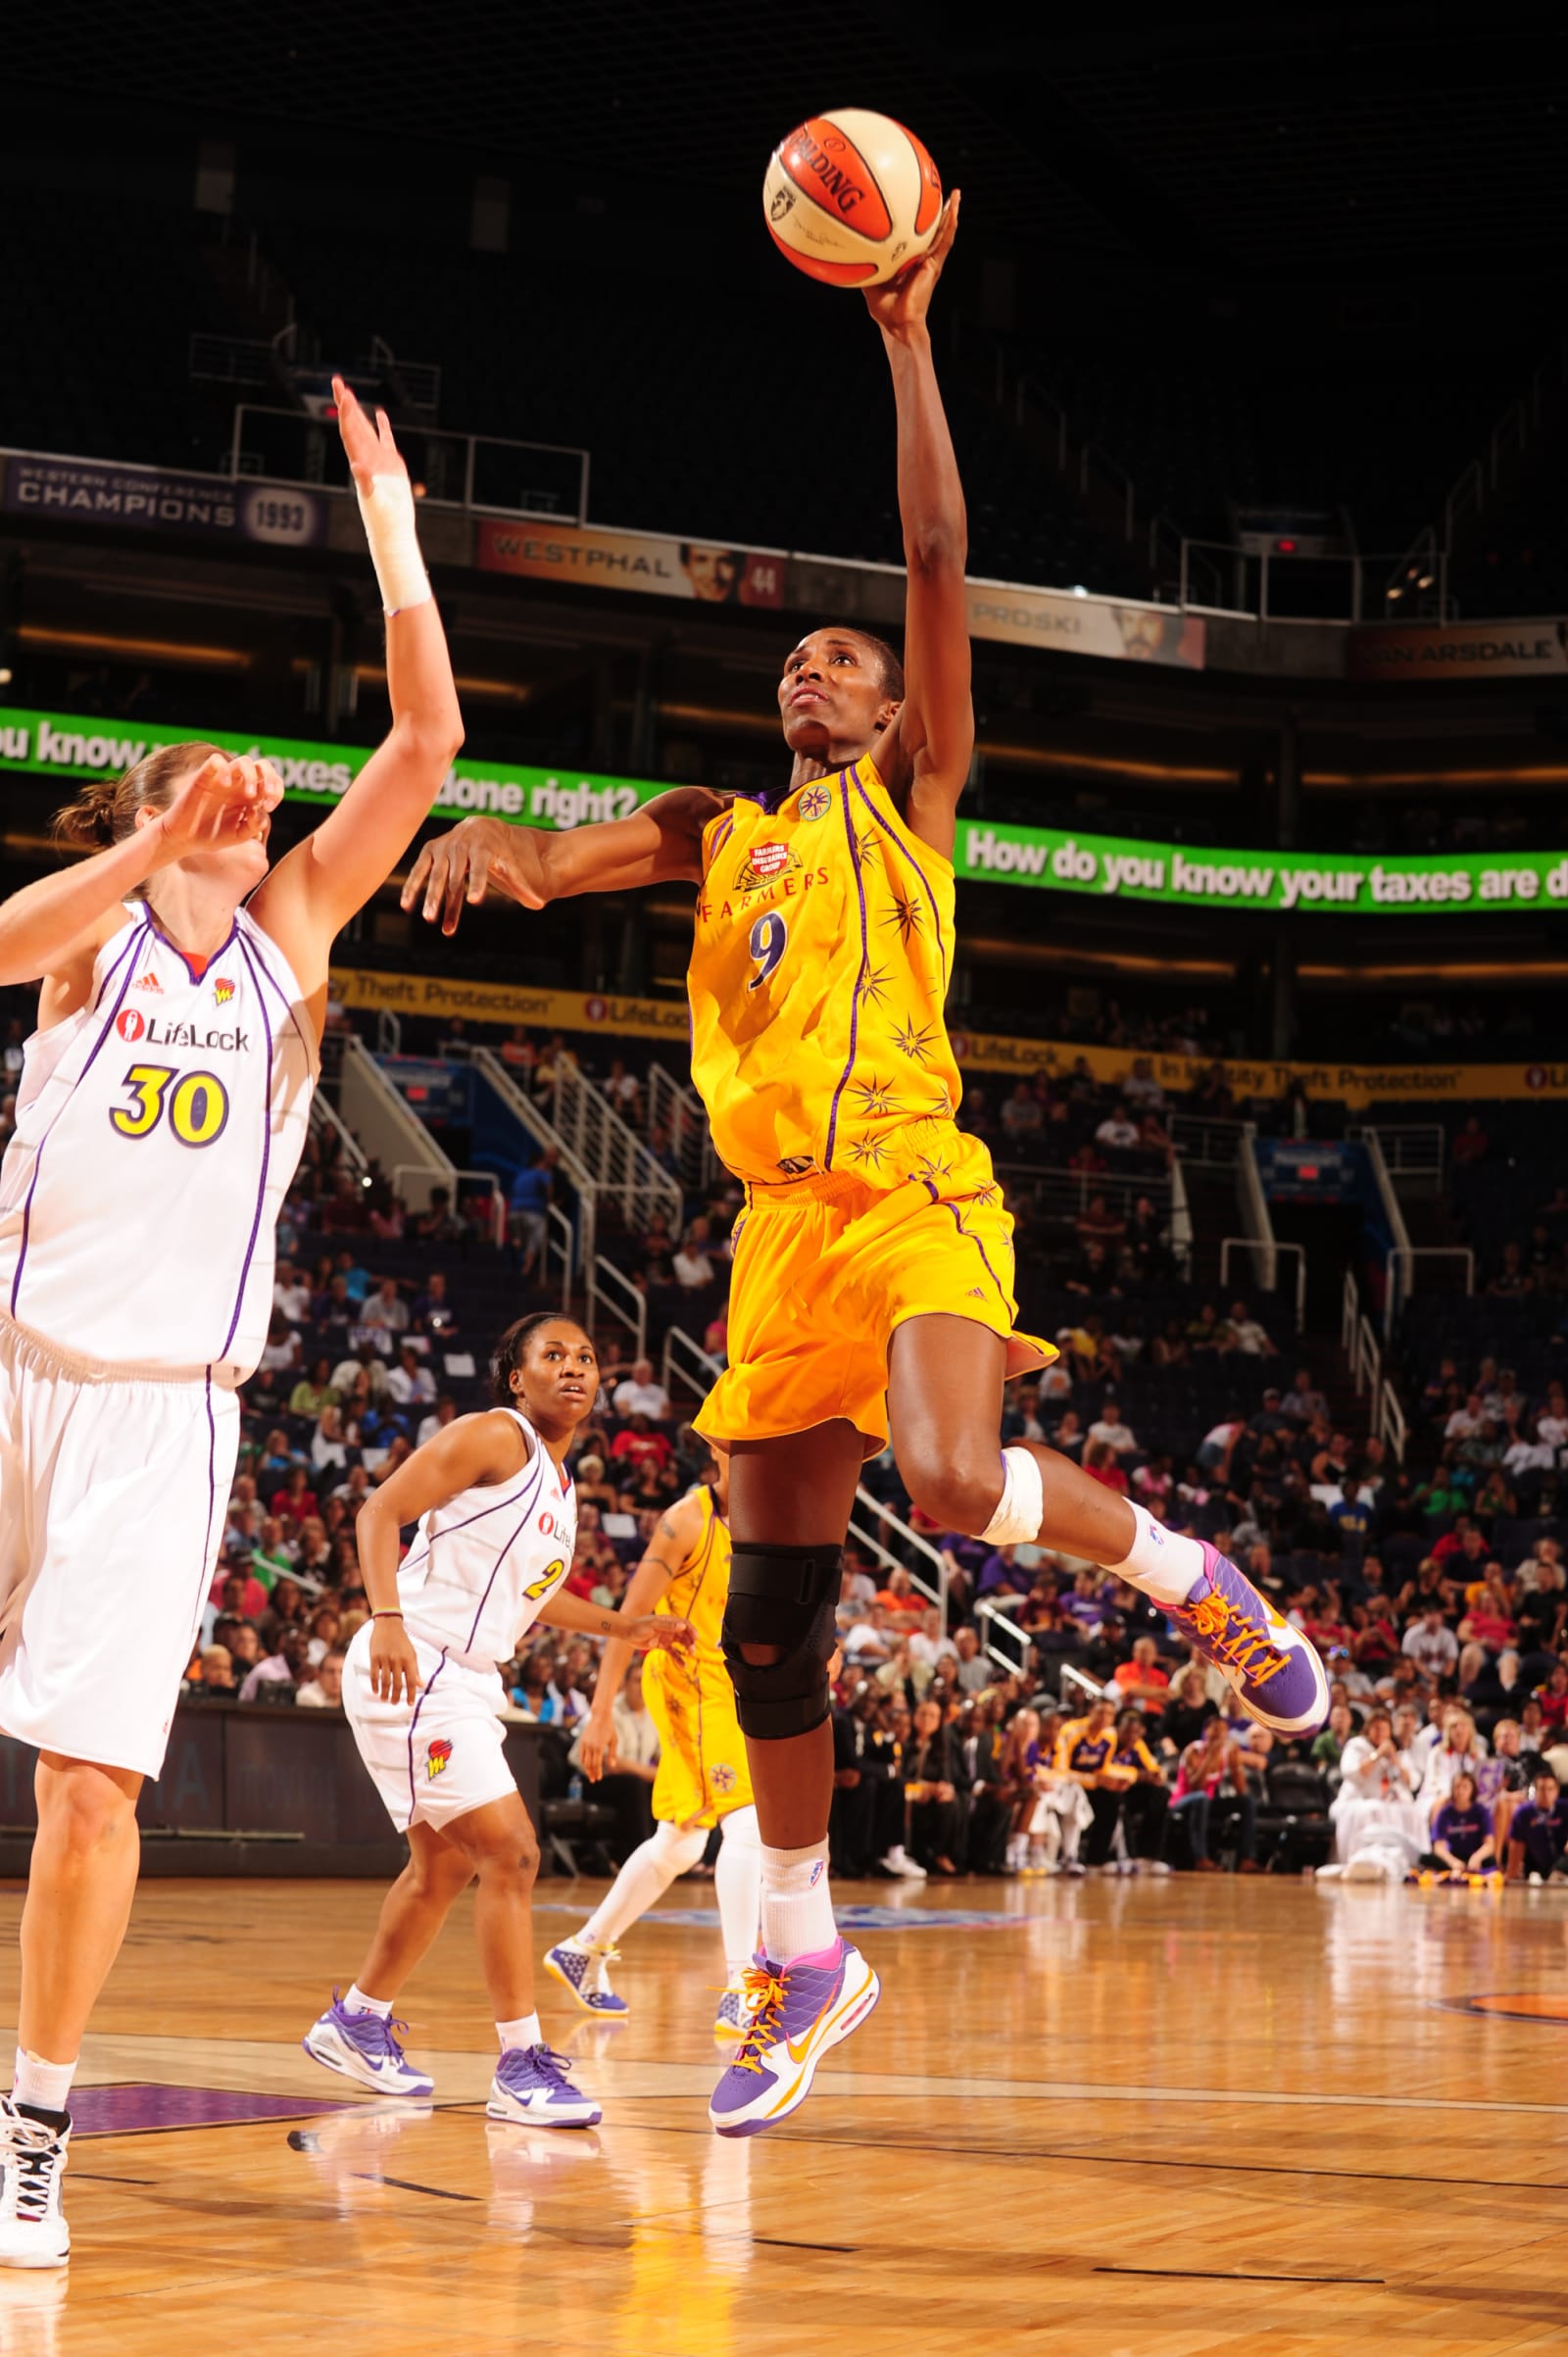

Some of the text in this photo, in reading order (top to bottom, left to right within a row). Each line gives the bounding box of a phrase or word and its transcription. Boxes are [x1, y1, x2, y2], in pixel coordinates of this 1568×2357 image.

[17, 480, 236, 527] CHAMPIONS
[256, 499, 307, 532] 1993
[494, 531, 672, 579] WESTPHAL
[751, 565, 777, 596] 44
[972, 602, 1082, 635] PROSKI
[1421, 638, 1552, 663] ARSDALE
[37, 720, 146, 770] know
[433, 767, 638, 830] done right?
[965, 827, 1049, 875] How
[1053, 840, 1098, 880] do
[1102, 854, 1165, 895] you
[1171, 853, 1274, 898] know
[1279, 868, 1365, 908] your
[1368, 863, 1472, 902] taxes
[1478, 868, 1540, 900] are
[700, 866, 829, 923] FARMERS
[747, 909, 788, 993] 9
[356, 972, 418, 1003] Theft
[423, 982, 552, 1014] Protection
[145, 1018, 250, 1053] LifeLock
[971, 1034, 1056, 1065] LifeLock
[1338, 1067, 1458, 1091] Protection
[109, 1063, 229, 1150] 30
[521, 1558, 565, 1601] 2
